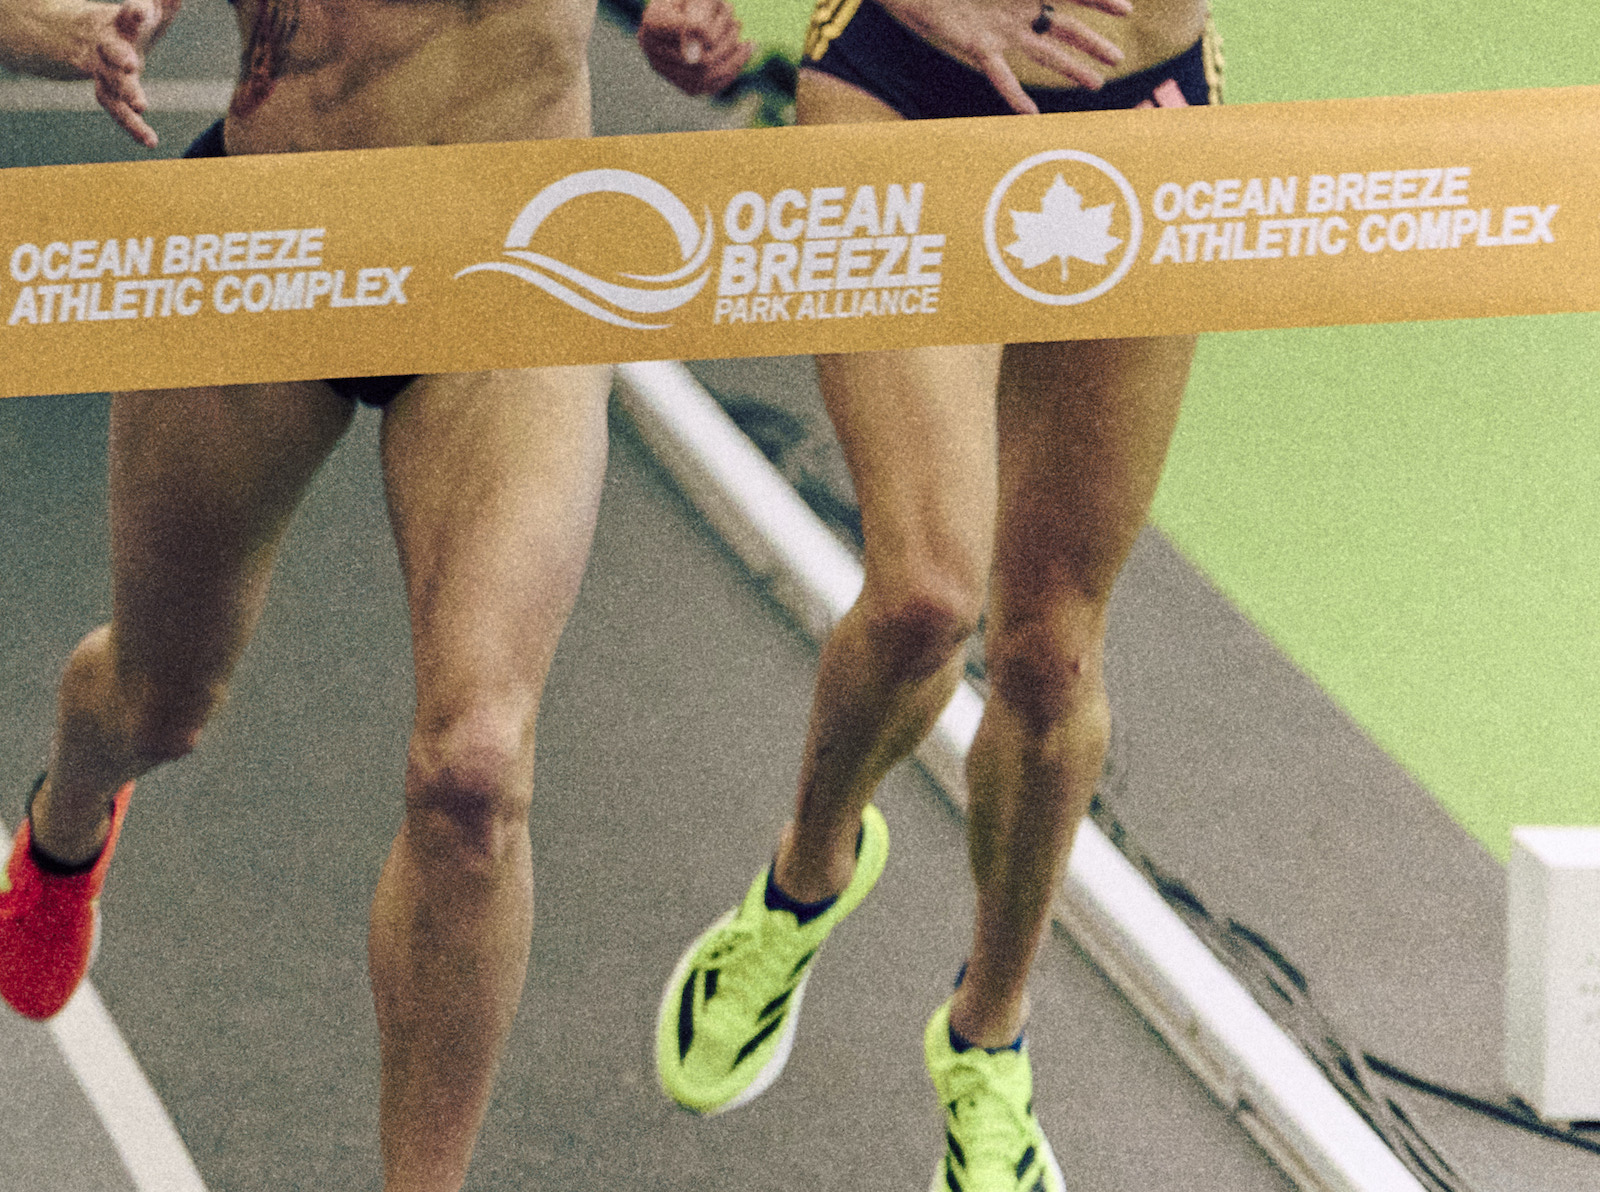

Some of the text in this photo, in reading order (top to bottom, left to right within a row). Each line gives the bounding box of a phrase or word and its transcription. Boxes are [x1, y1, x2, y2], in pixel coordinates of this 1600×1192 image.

[723, 182, 925, 243] OCEAN
[1152, 166, 1471, 221] OCEAN BREEZE
[10, 227, 326, 282] OCEAN BREEZE
[1150, 204, 1559, 264] ATHLETIC COMPLEX
[718, 234, 946, 296] BREEZE
[7, 266, 412, 325] ATHLETIC COMPLEX
[713, 287, 940, 324] PARK ALLIANCE
